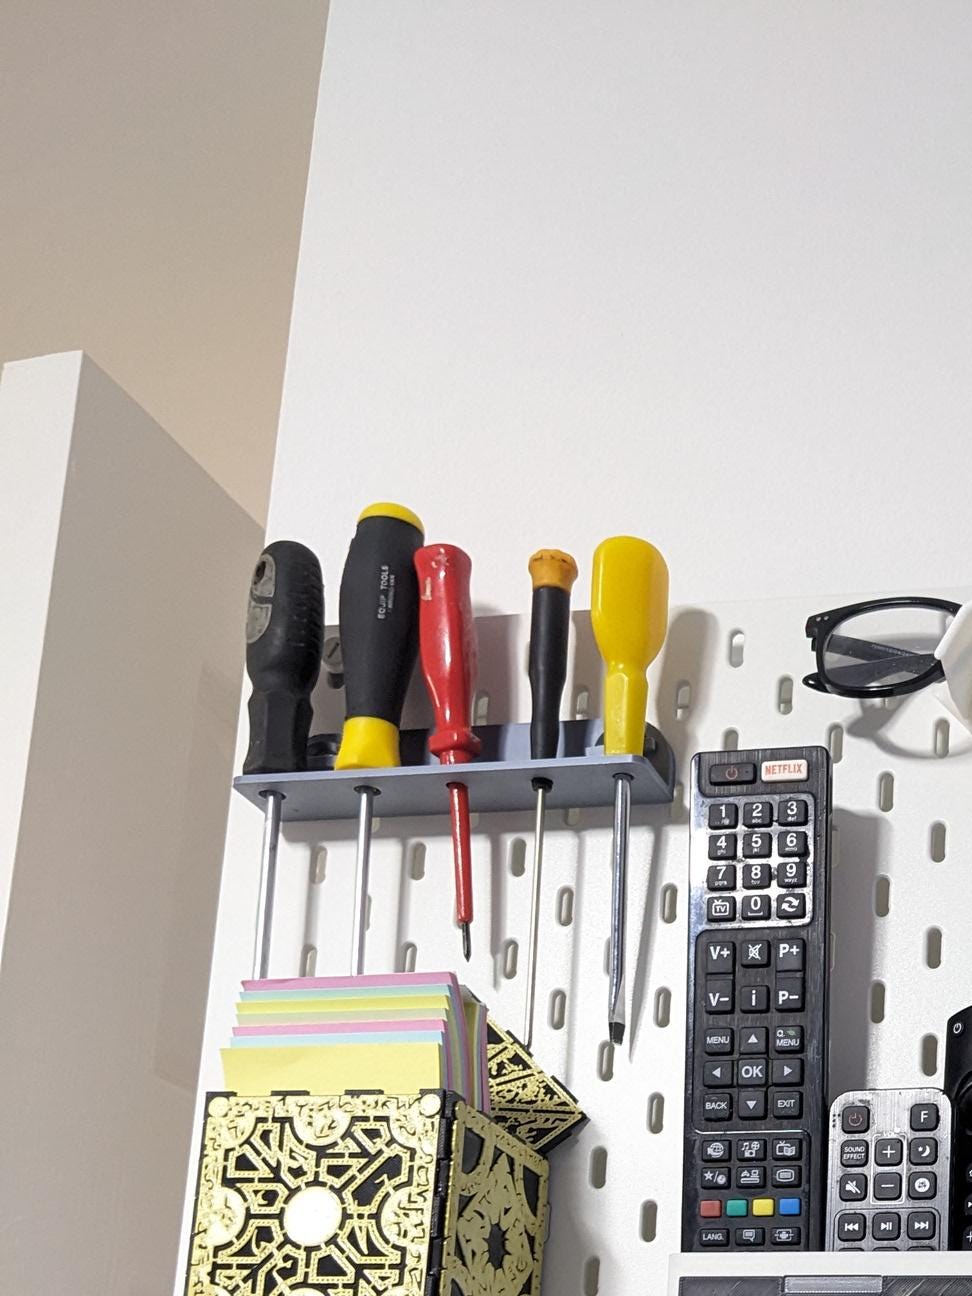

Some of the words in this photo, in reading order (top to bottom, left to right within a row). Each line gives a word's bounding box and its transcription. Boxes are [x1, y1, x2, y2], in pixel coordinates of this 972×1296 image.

[380, 565, 389, 590] TOOLS
[765, 763, 803, 776] NETFLIX
[720, 804, 726, 818] 1
[752, 803, 762, 817] 2
[787, 801, 797, 815] 3
[716, 835, 727, 849] 4
[751, 834, 761, 847] 5
[786, 833, 797, 846] 6
[716, 866, 726, 879] 7
[751, 865, 761, 879] 8
[786, 863, 796, 877] 9
[750, 897, 762, 910] 0
[709, 946, 730, 959] V+
[779, 944, 800, 957] P+
[706, 1036, 730, 1044] MENU
[776, 1038, 800, 1047] MENU
[741, 1066, 763, 1078] OK
[705, 1101, 727, 1110] BACK
[777, 1100, 795, 1108] EXIT
[921, 1111, 928, 1123] F
[702, 1232, 724, 1241] LANG.
